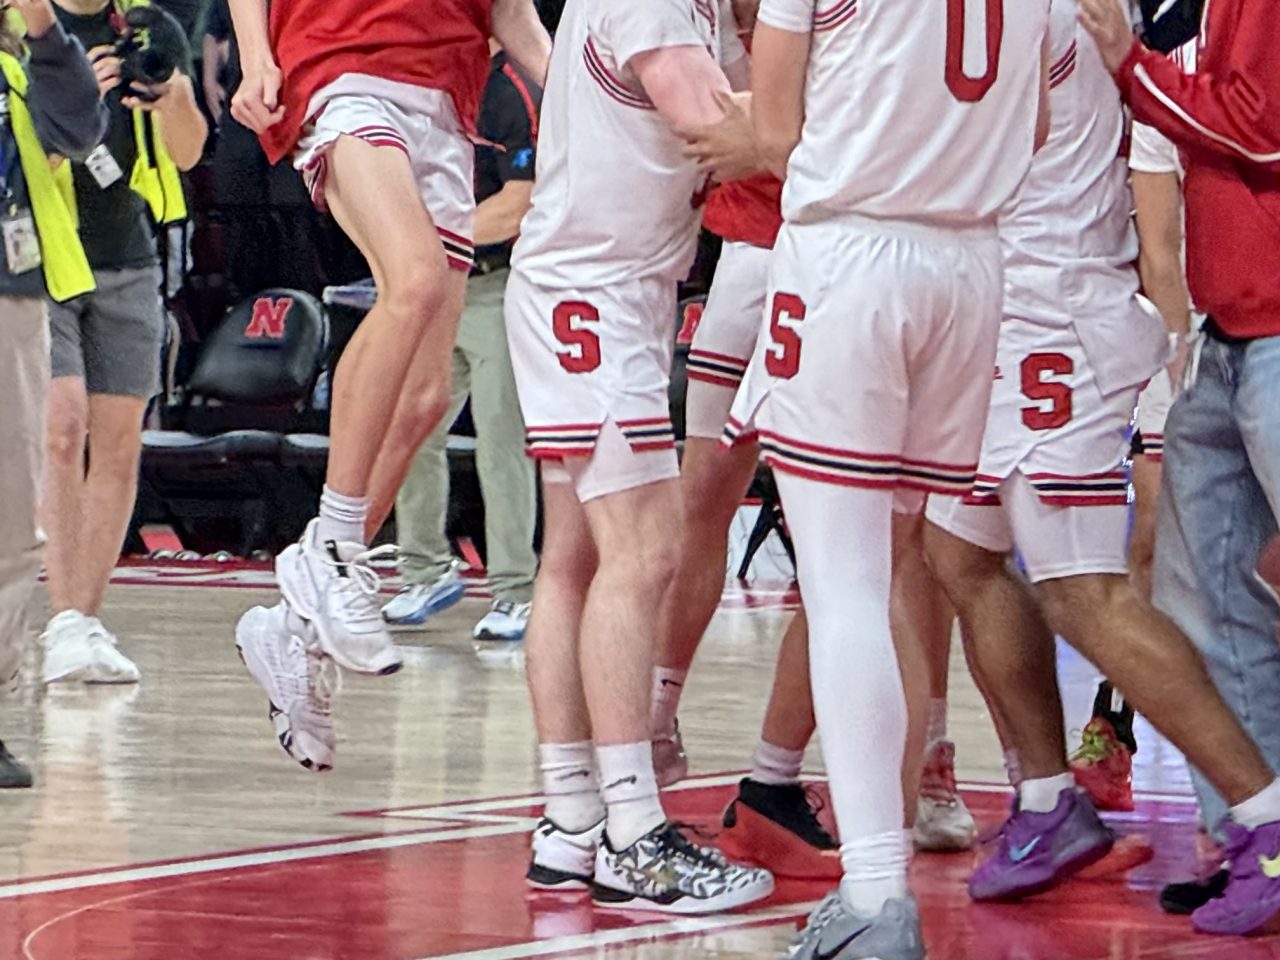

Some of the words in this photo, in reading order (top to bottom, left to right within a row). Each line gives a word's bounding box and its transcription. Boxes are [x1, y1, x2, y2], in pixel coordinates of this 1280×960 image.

[244, 297, 294, 338] N
[552, 300, 602, 374] S
[765, 291, 807, 380] S
[1020, 352, 1074, 431] S
